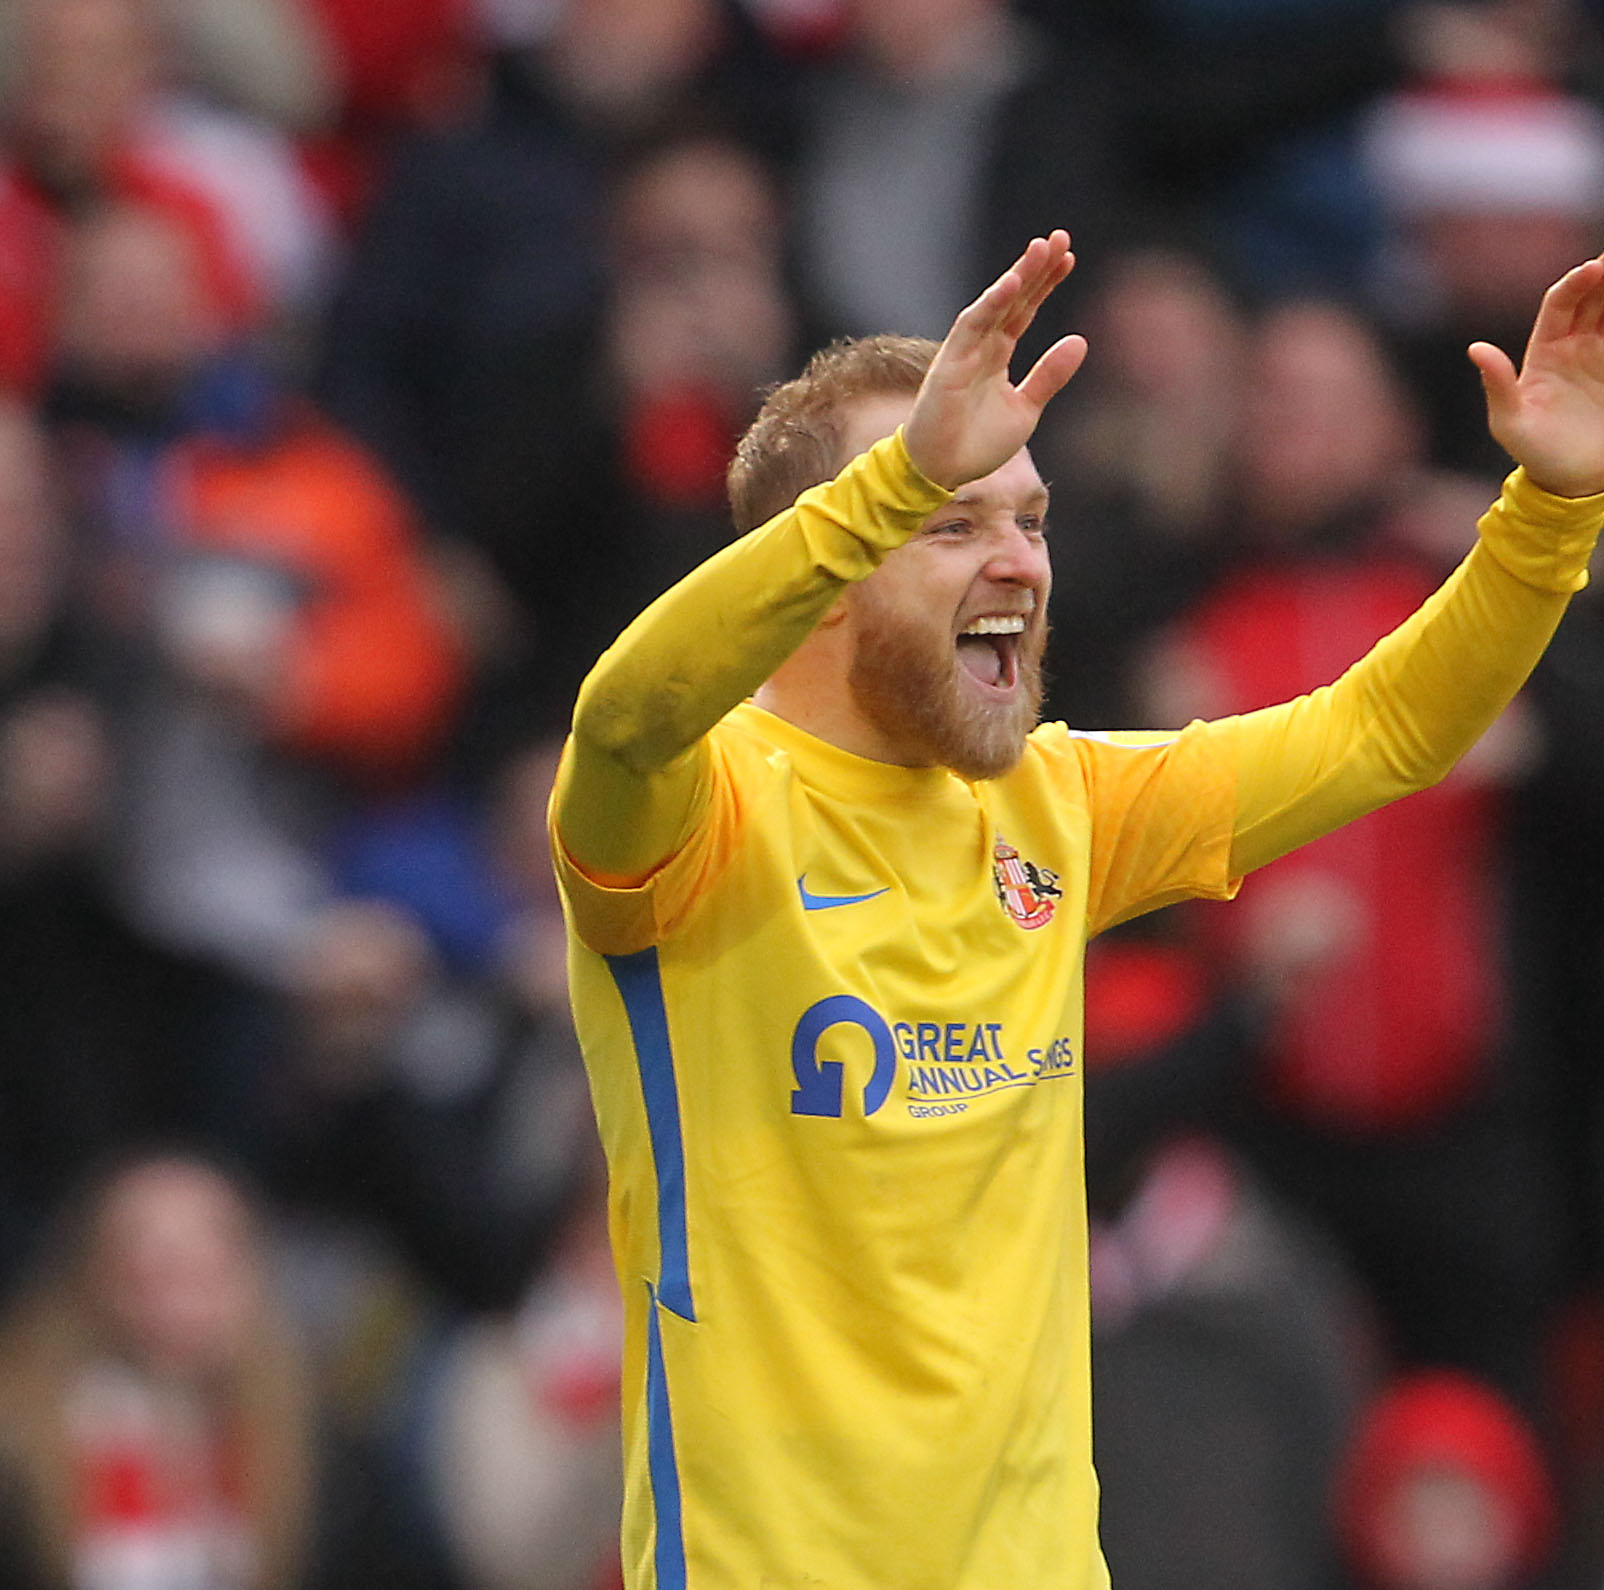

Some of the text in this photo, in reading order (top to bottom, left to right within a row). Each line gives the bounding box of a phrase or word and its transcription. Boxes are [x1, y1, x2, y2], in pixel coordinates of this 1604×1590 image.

[893, 1021, 1004, 1063] GREAT
[907, 1063, 1028, 1095] ANNUAL
[907, 1102, 969, 1119] GROUP
